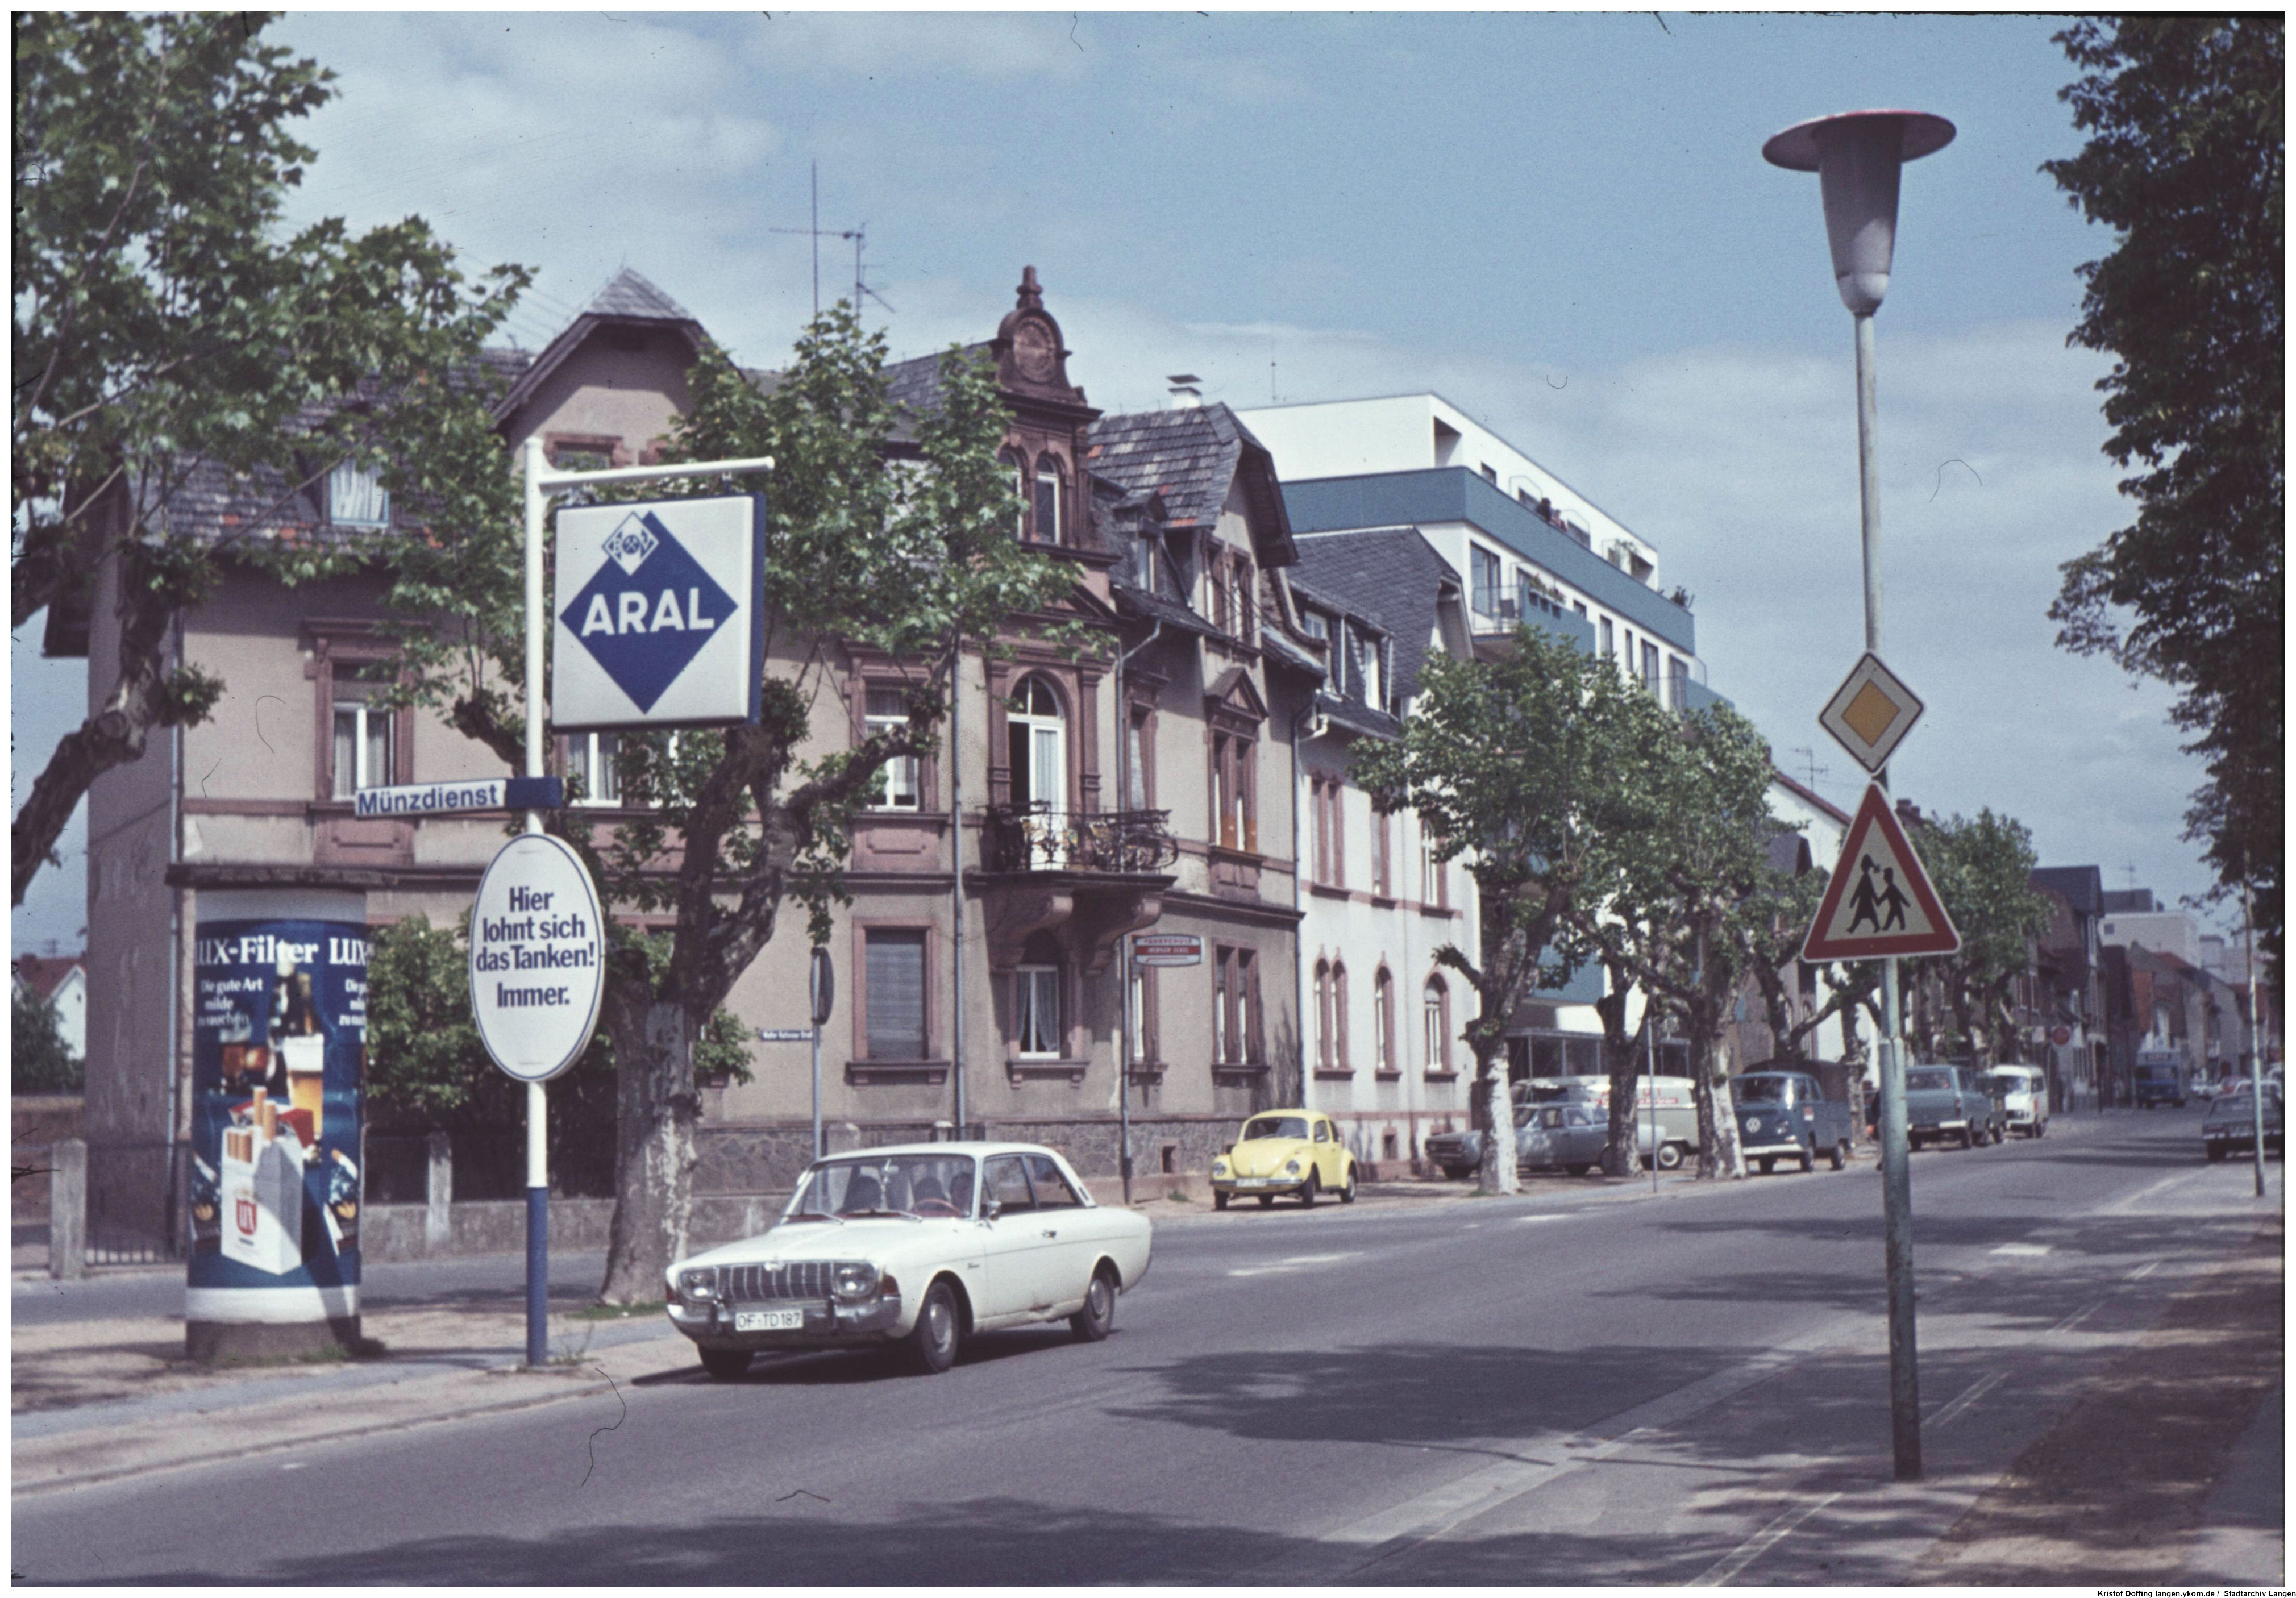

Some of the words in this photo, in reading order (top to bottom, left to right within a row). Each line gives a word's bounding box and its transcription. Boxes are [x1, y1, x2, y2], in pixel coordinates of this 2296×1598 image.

[580, 587, 715, 637] ARAL
[358, 784, 498, 814] Münzdienst
[509, 886, 554, 912] Hier
[483, 916, 535, 942] lohnt
[540, 913, 585, 939] sich
[242, 977, 264, 992] Art
[497, 981, 570, 1008] Immer.
